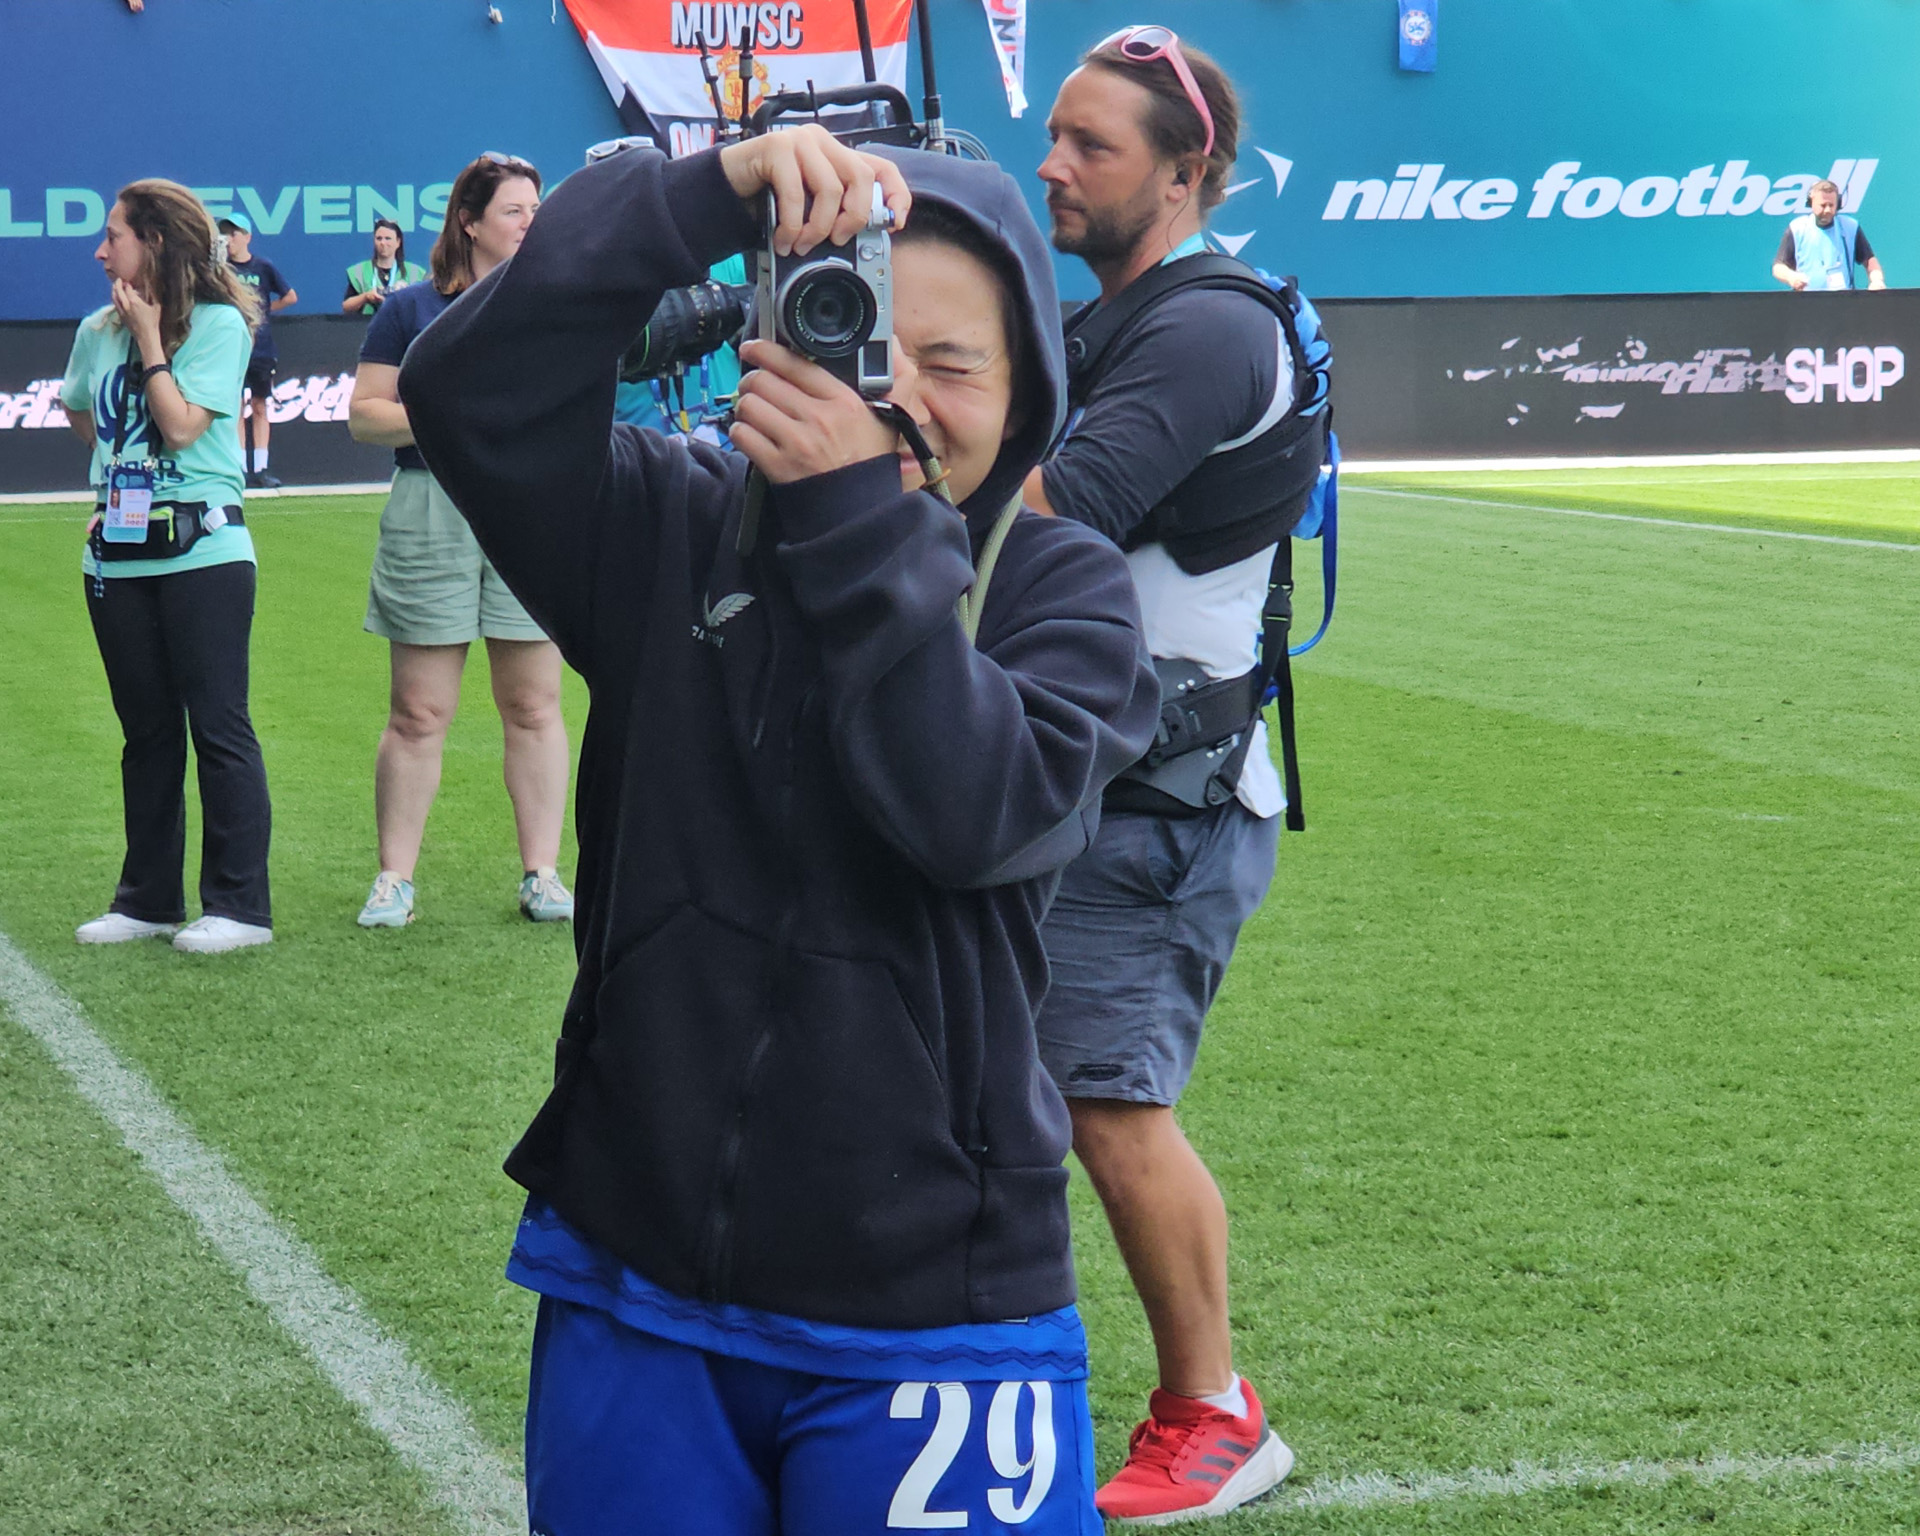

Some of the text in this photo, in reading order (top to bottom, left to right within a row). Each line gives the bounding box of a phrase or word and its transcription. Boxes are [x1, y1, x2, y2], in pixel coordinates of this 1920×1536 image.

[671, 1, 803, 49] MUWSC
[1322, 158, 1879, 220] nike football
[1785, 345, 1904, 403] SHOP
[887, 1381, 1056, 1528] 29
